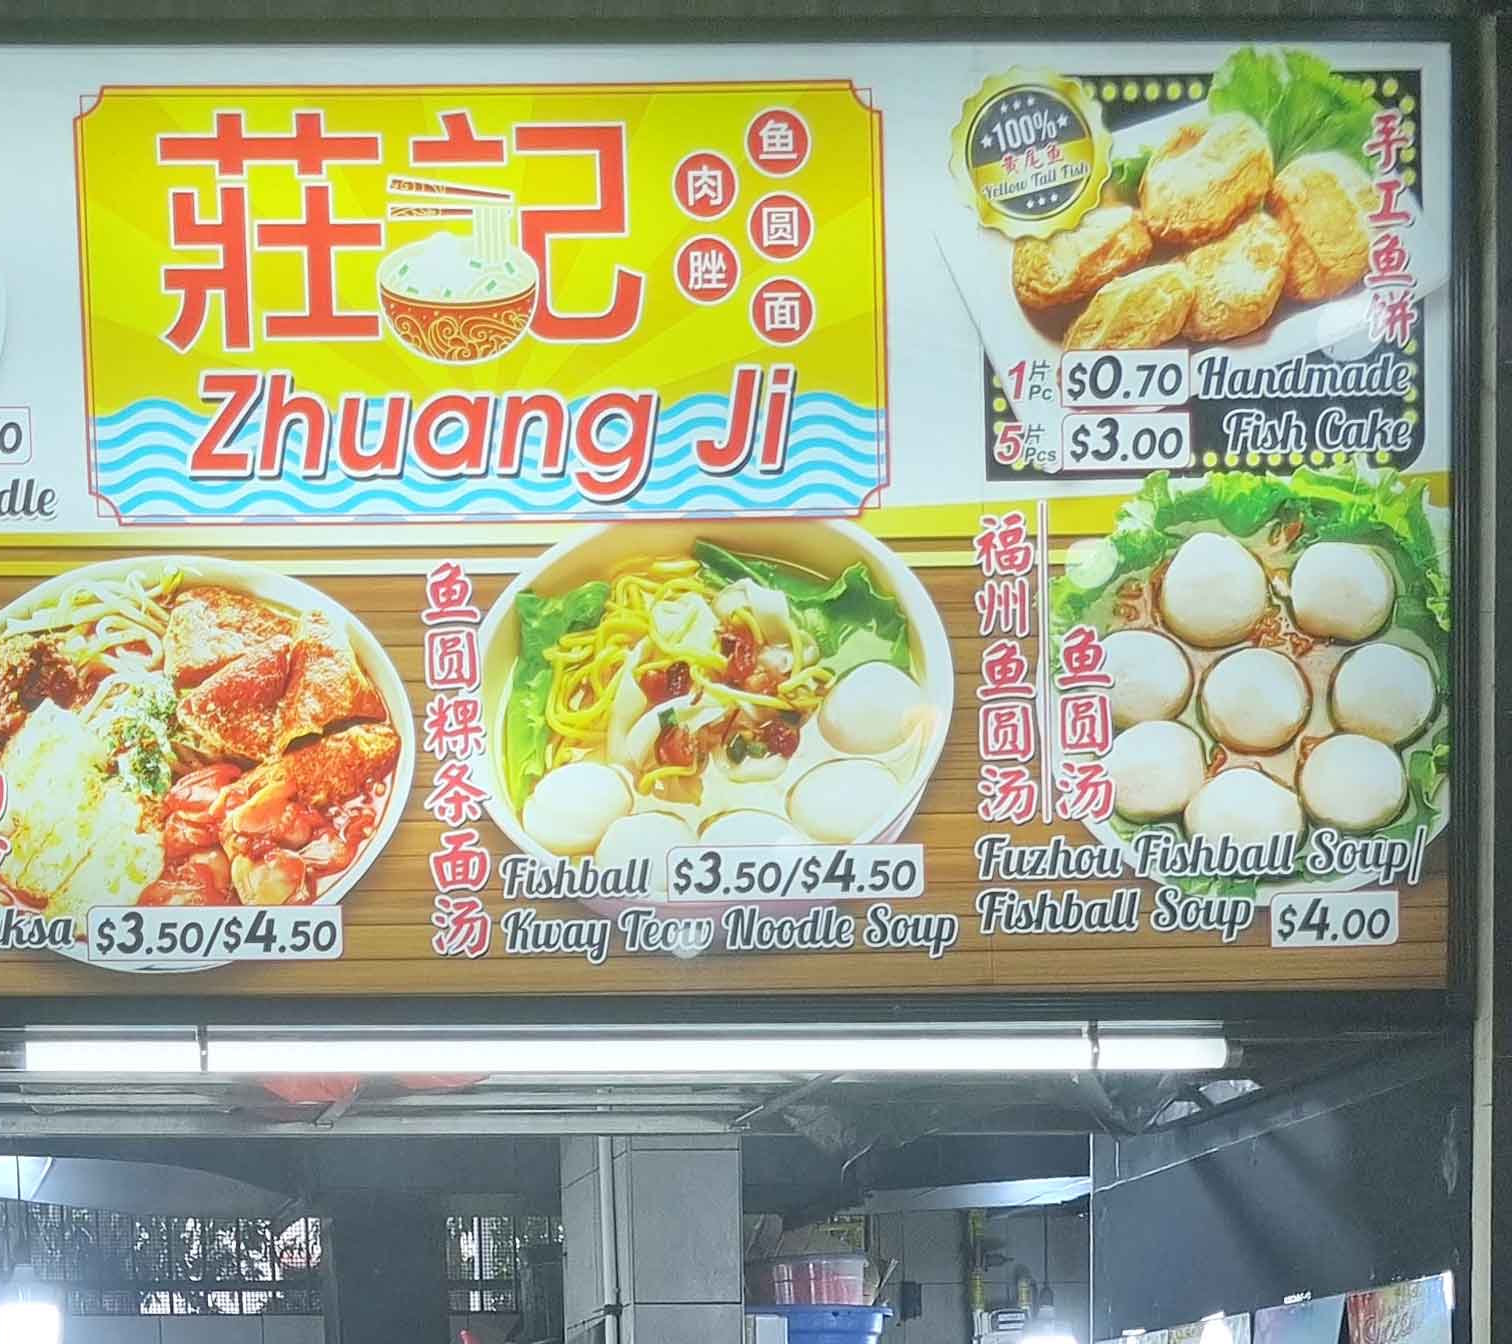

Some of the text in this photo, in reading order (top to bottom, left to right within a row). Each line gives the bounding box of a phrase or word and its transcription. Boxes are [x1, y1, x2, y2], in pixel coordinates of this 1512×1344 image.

[992, 109, 1057, 152] 100%
[983, 160, 1090, 200] Yellow Tail Fish
[1365, 108, 1417, 346] 手工鱼饼
[1008, 361, 1026, 400] 1
[1029, 360, 1050, 381] 片
[1029, 385, 1053, 400] Pc
[1067, 355, 1183, 400] $0.70
[1197, 354, 1410, 399] Handmade
[189, 365, 795, 503] Zhuang Ji
[999, 425, 1023, 462] 5
[1025, 424, 1045, 444] 片
[1070, 417, 1183, 463] $3.00
[1224, 407, 1412, 454] Fish Cake
[1025, 448, 1057, 463] Pcs
[975, 512, 1037, 823] 福州鱼圆汤
[1056, 627, 1115, 824] 鱼圆汤
[422, 561, 490, 960] 鱼圆粿条面汤
[500, 855, 651, 899] Fishball
[673, 850, 917, 896] $3.50/$4.50
[975, 834, 1120, 880] Fuzhou
[1133, 832, 1295, 876] Fishball
[96, 910, 337, 956] $3.50/$4.50
[500, 904, 958, 963] Kway Teow Noodle Soup
[976, 889, 1254, 940] Fishball Soup
[1278, 904, 1390, 942] $4.00
